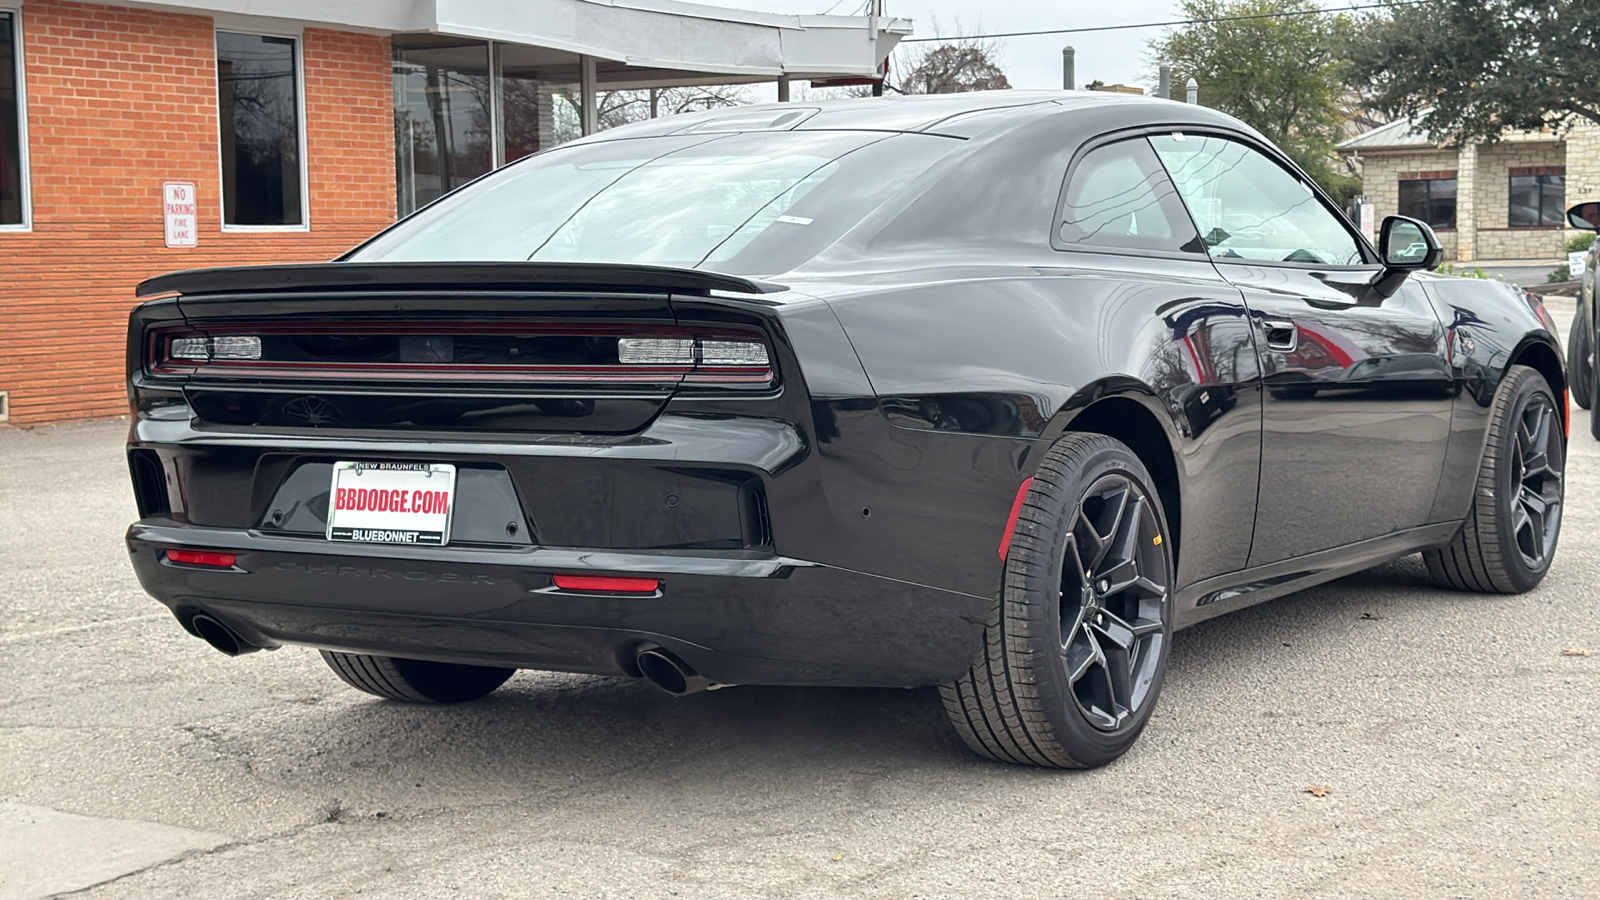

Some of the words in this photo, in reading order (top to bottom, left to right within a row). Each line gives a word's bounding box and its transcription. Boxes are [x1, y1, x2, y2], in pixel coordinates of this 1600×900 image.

[173, 188, 185, 200] NO
[167, 204, 193, 215] PARKING
[174, 219, 187, 227] FIRE
[173, 231, 188, 239] LANE
[359, 462, 378, 470] NEW
[379, 463, 429, 471] BRAUNFELS
[335, 488, 449, 514] BBDODGE.COM
[352, 529, 420, 543] BLUEBONNET
[274, 561, 494, 585] CHARGER
